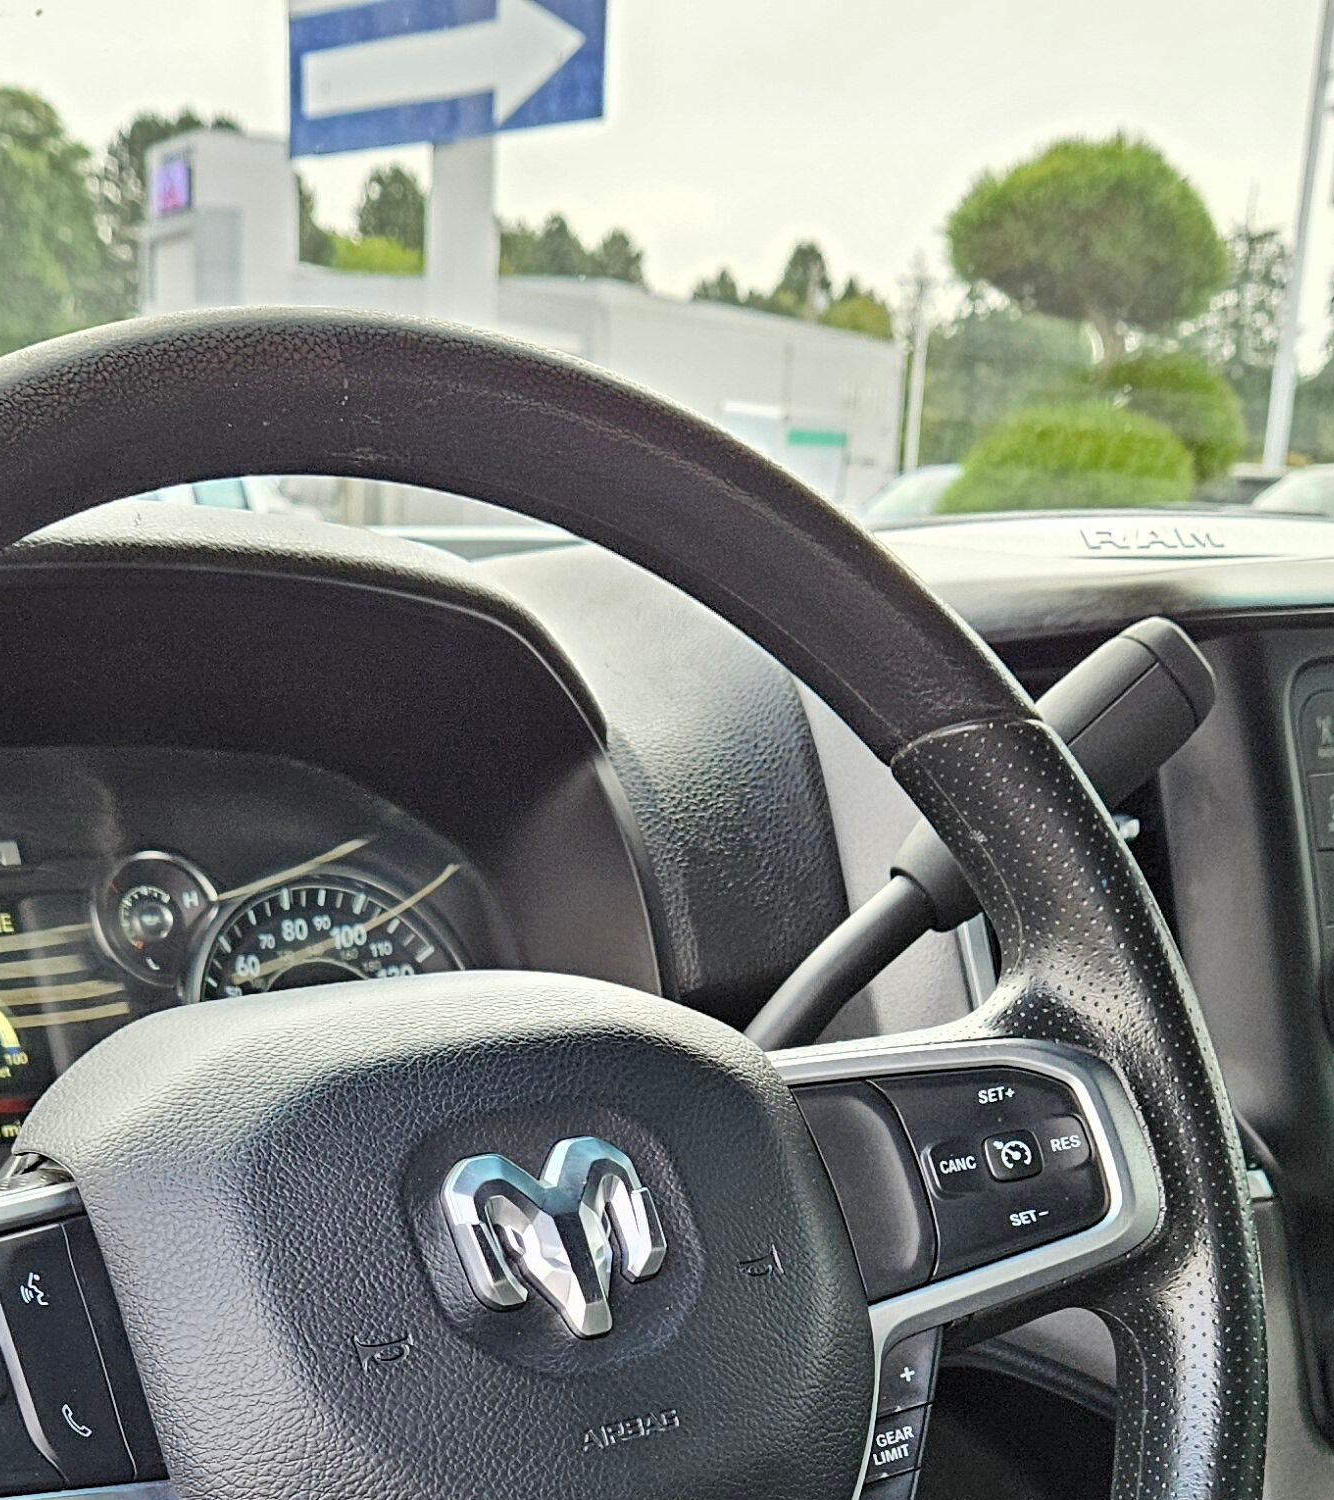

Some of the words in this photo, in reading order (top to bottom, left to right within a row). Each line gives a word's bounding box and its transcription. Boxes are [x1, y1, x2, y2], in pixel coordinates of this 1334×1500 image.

[1080, 528, 1225, 549] RAM
[182, 890, 199, 908] H
[281, 918, 308, 942] 80
[312, 915, 331, 931] 90
[258, 933, 275, 949] 70
[330, 923, 367, 949] 100
[370, 940, 393, 958] 110
[235, 955, 260, 977] 60
[1050, 1134, 1082, 1153] RES
[940, 1155, 976, 1175] CANC
[581, 1408, 680, 1452] AIRBAG
[876, 1426, 914, 1447] GEAR
[873, 1445, 909, 1466] LIMIT
